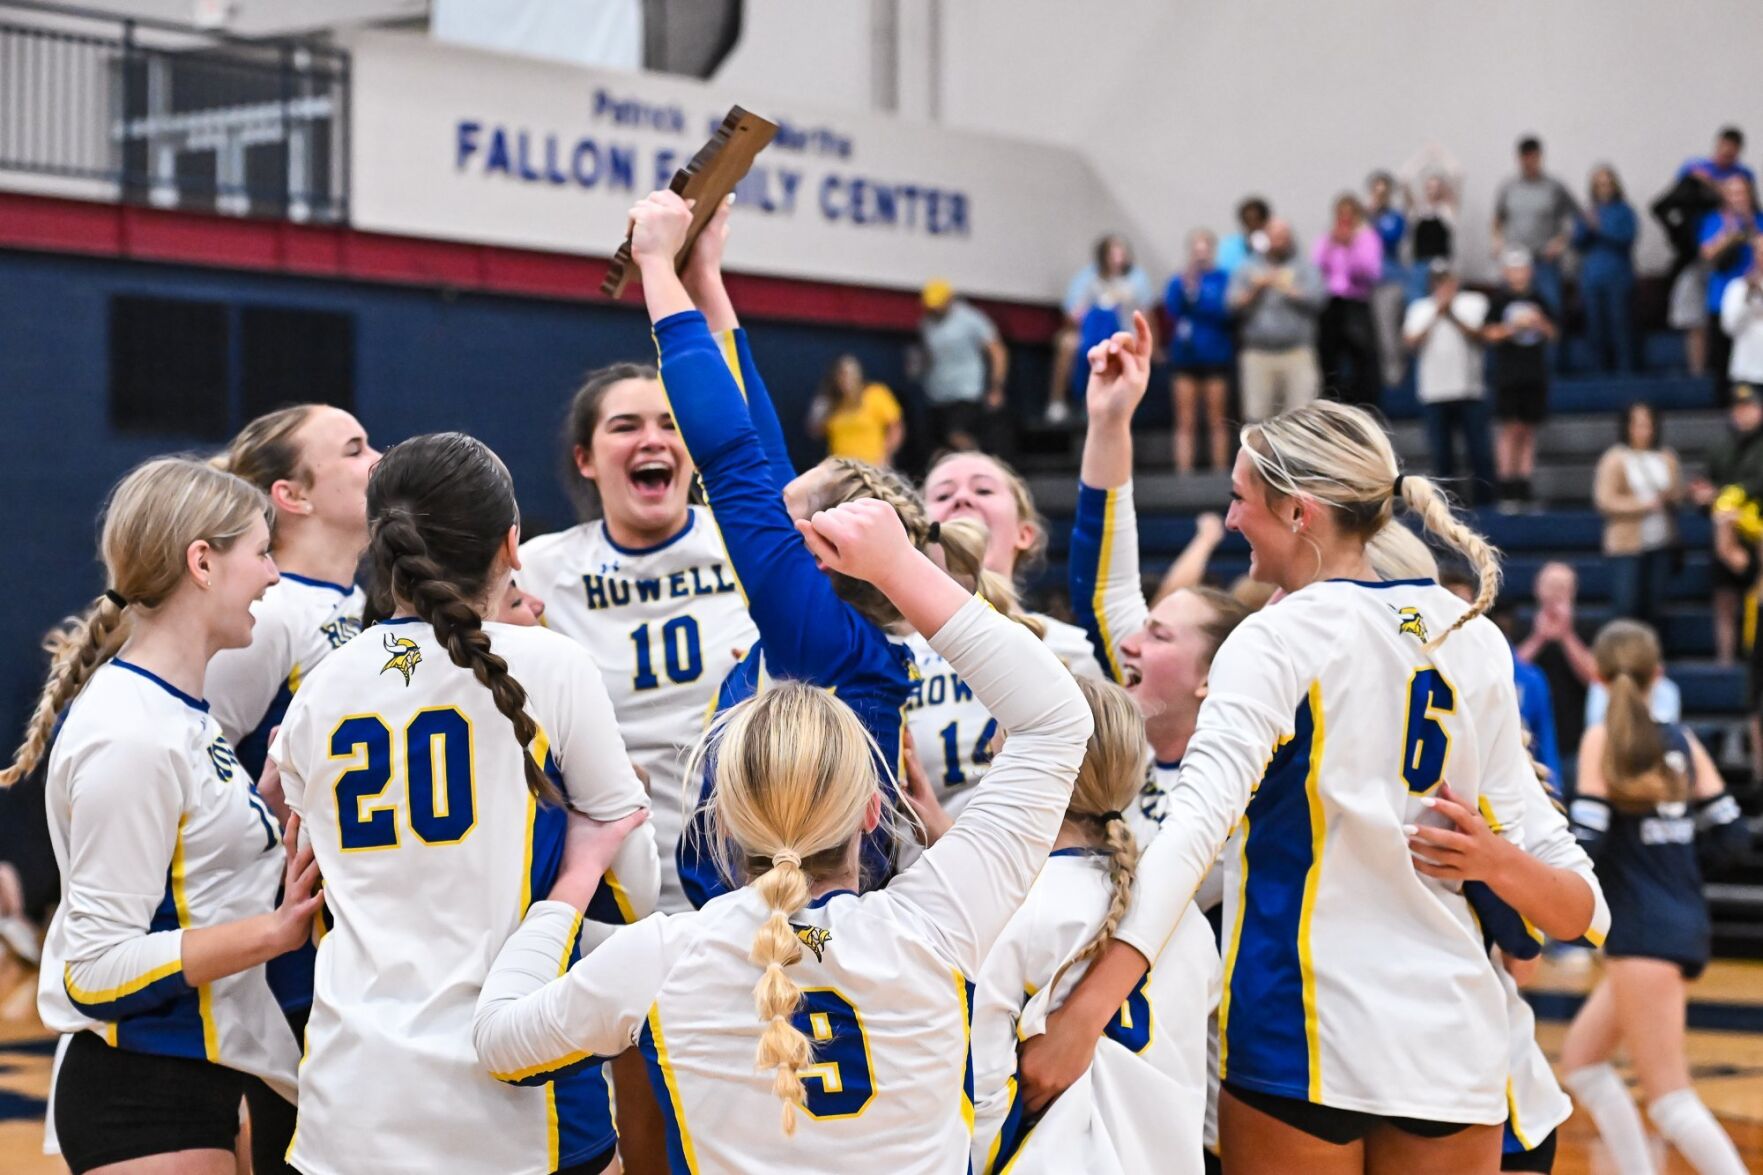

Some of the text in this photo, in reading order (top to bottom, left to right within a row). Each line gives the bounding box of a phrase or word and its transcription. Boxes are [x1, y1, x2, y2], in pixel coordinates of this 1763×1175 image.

[456, 119, 637, 193] FALLON
[818, 173, 970, 238] CENTER
[582, 564, 737, 609] HOWELL
[630, 614, 704, 691] 10
[328, 705, 478, 852] 20
[1400, 664, 1459, 797] 6
[789, 986, 880, 1122] 9
